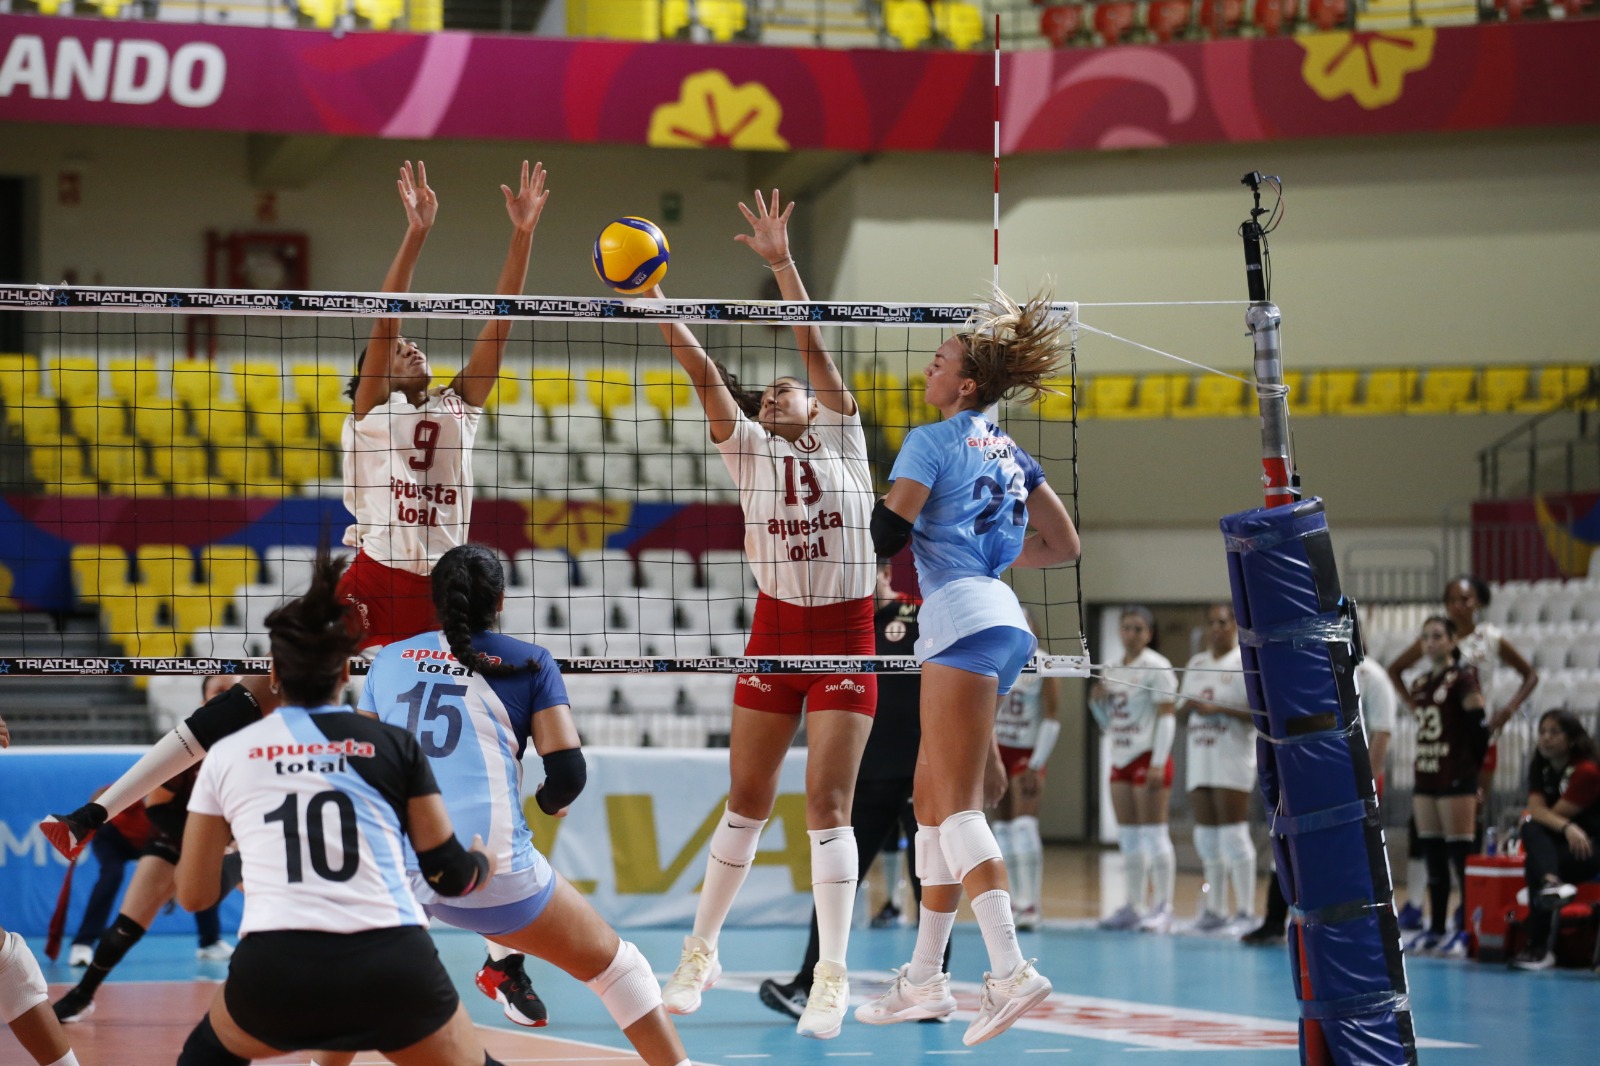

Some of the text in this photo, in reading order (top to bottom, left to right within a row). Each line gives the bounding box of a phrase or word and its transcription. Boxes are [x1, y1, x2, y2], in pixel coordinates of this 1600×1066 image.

[0, 34, 227, 108] ANDO
[75, 291, 168, 303] TRIATHLON
[188, 294, 279, 306] TRIATHLON
[299, 296, 388, 309] TRIATHLON
[408, 300, 496, 310] TRIATHLON
[515, 301, 601, 312] TRIATHLON
[725, 306, 810, 316] TRIATHLON
[828, 306, 911, 318] TRIATHLON
[408, 419, 441, 472] 9
[783, 456, 824, 506] 13
[401, 649, 502, 665] apueta
[16, 659, 109, 670] TRIATHLON
[130, 659, 222, 670] TRIATHLON
[417, 661, 474, 678] total
[568, 658, 654, 669] TRIATHLON
[673, 659, 759, 668] TRIATHLON
[778, 660, 862, 669] TRIATHLON
[825, 683, 866, 694] SAN CARLOS
[396, 681, 469, 759] 15
[248, 738, 376, 760] apuesta
[274, 755, 347, 775] total
[263, 790, 360, 884] 10
